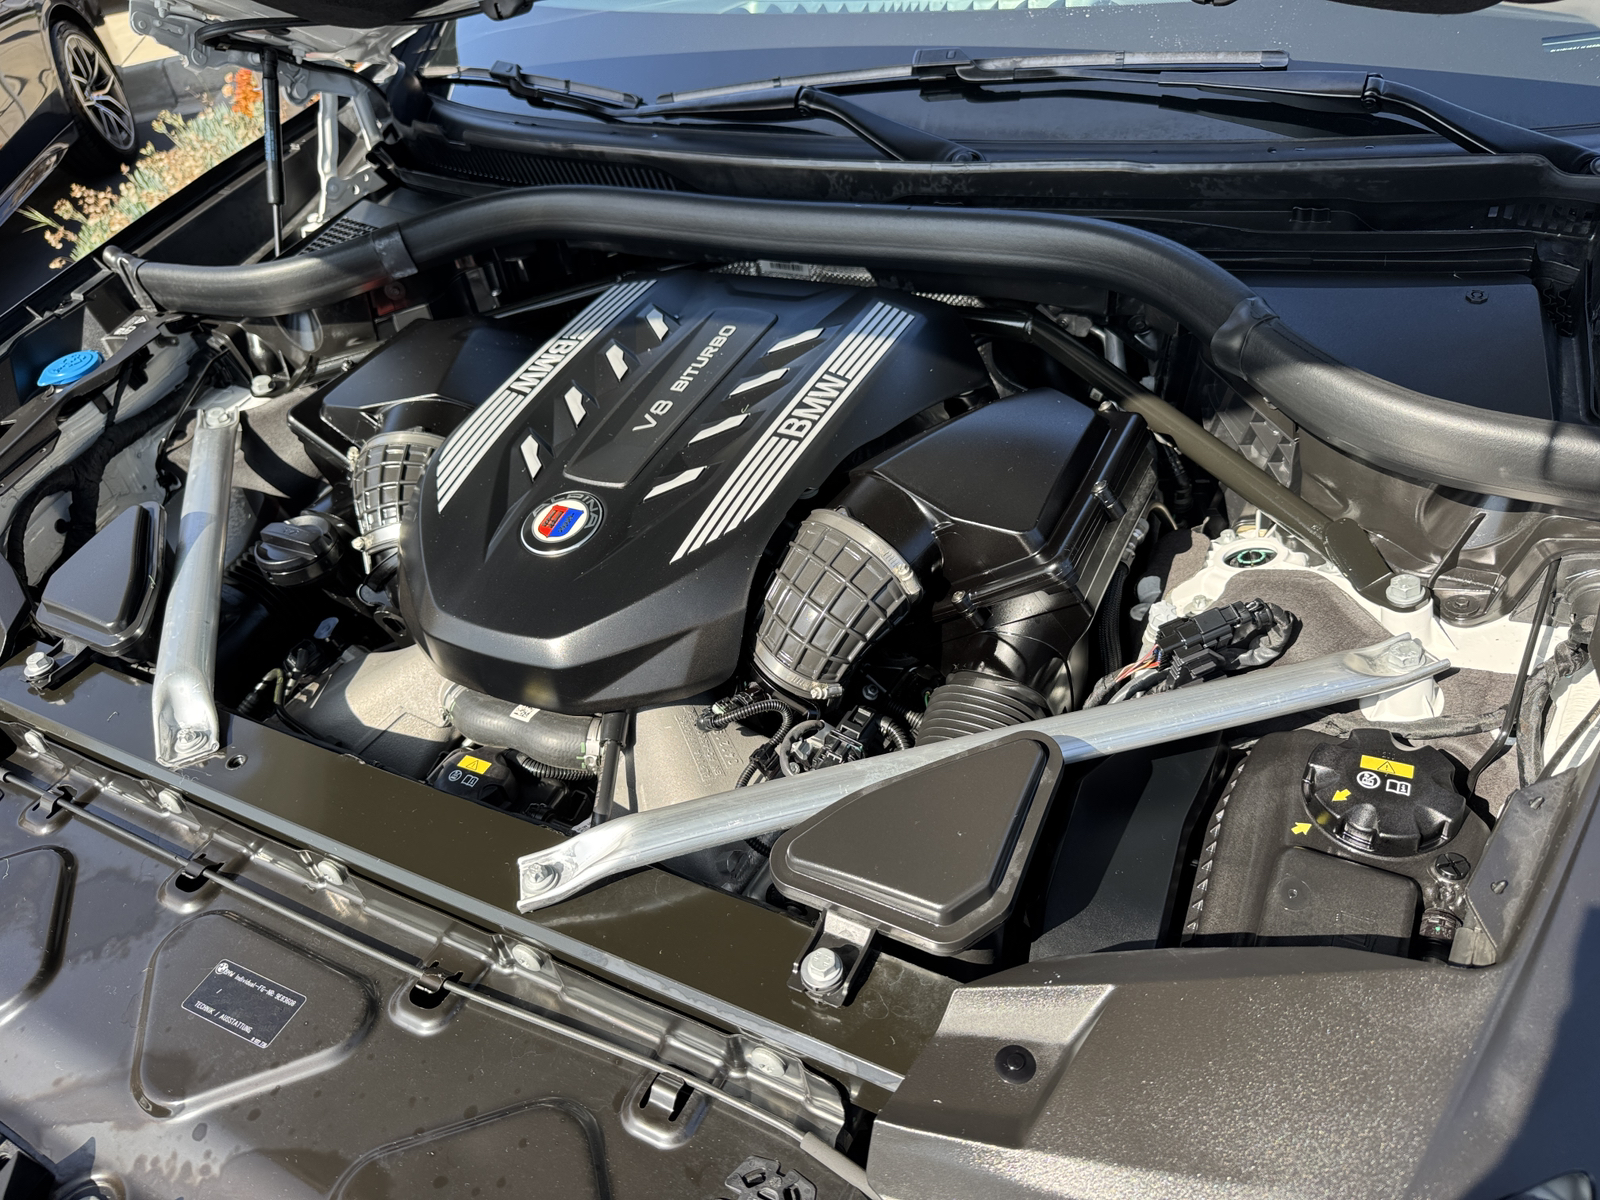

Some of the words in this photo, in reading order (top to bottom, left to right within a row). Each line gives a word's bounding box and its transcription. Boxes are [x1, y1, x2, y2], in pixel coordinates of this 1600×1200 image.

[509, 340, 580, 394] BMW
[632, 400, 673, 431] V8
[670, 325, 737, 393] BITURBO
[776, 374, 848, 438] BMW
[532, 493, 599, 529] ALPINA
[194, 1000, 216, 1015] TECHNIK
[218, 1013, 253, 1034] AUSSTATTUNG
